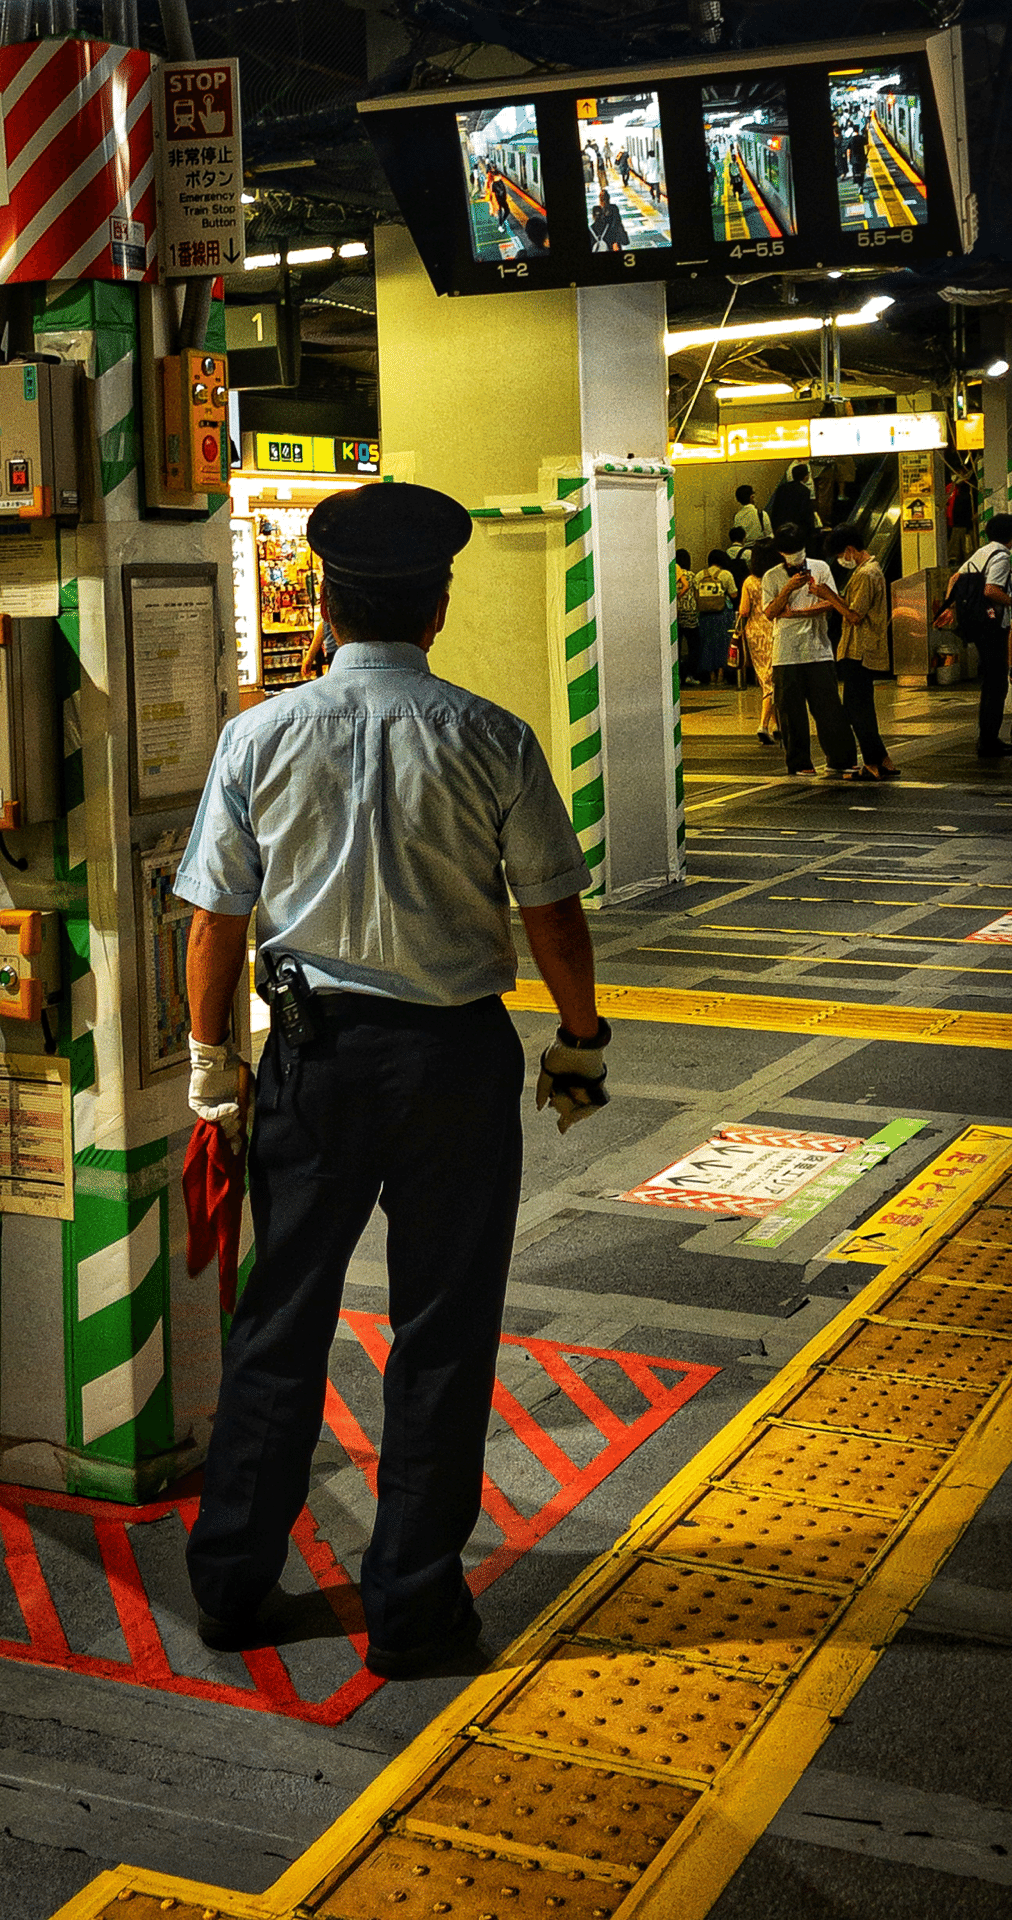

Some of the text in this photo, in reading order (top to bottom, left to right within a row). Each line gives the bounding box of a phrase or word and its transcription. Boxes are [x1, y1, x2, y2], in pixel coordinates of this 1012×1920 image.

[169, 71, 227, 93] STOP
[168, 145, 233, 167] 非常停止
[185, 171, 233, 189] ボタン
[179, 191, 235, 203] Emergency
[184, 204, 236, 217] Train Stop
[202, 217, 236, 228] Button
[857, 228, 912, 247] 5.5-6
[169, 239, 221, 267] 1番線用
[729, 241, 784, 259] 4-5.5
[623, 253, 636, 268] 3
[497, 263, 529, 279] 1-2
[251, 312, 264, 342] 1
[878, 1151, 988, 1227] 足もと注意
